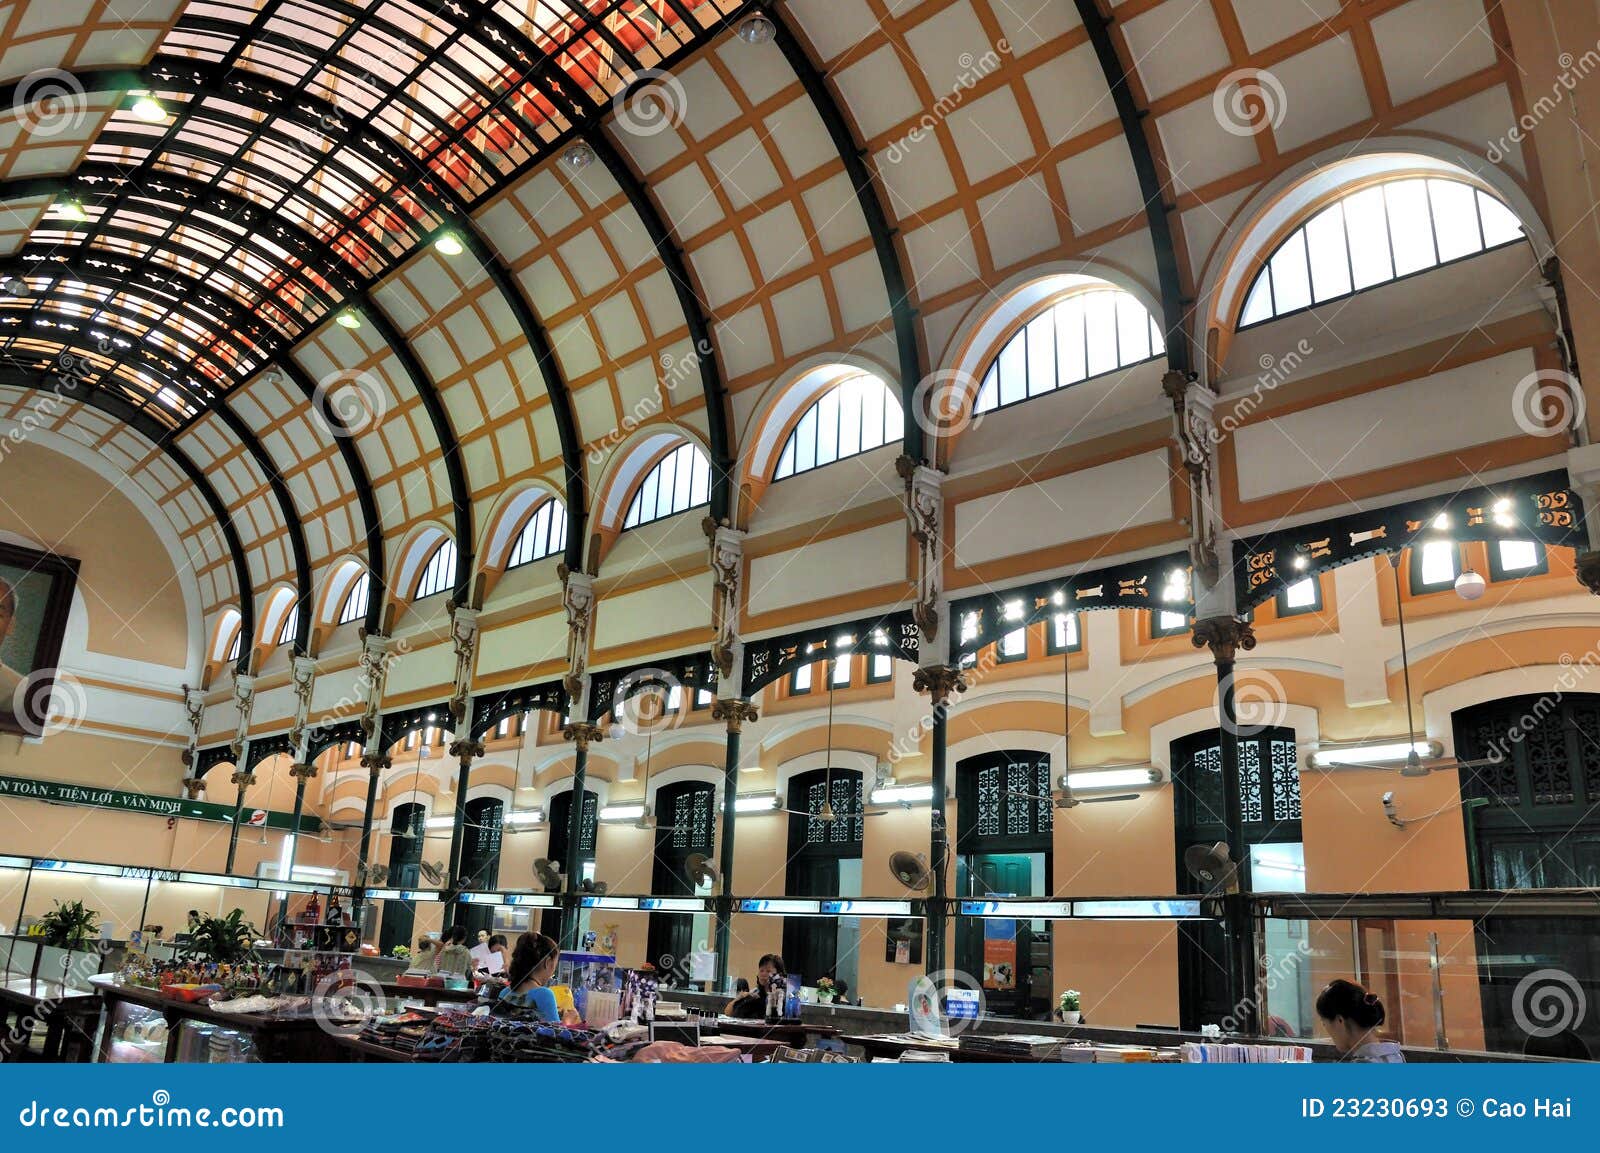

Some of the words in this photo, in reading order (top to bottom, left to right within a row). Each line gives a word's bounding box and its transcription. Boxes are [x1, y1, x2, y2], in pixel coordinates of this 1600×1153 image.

[0, 781, 9, 790] N
[12, 781, 48, 795] TOÀN
[123, 795, 147, 807] VĂN
[149, 799, 182, 813] MINH
